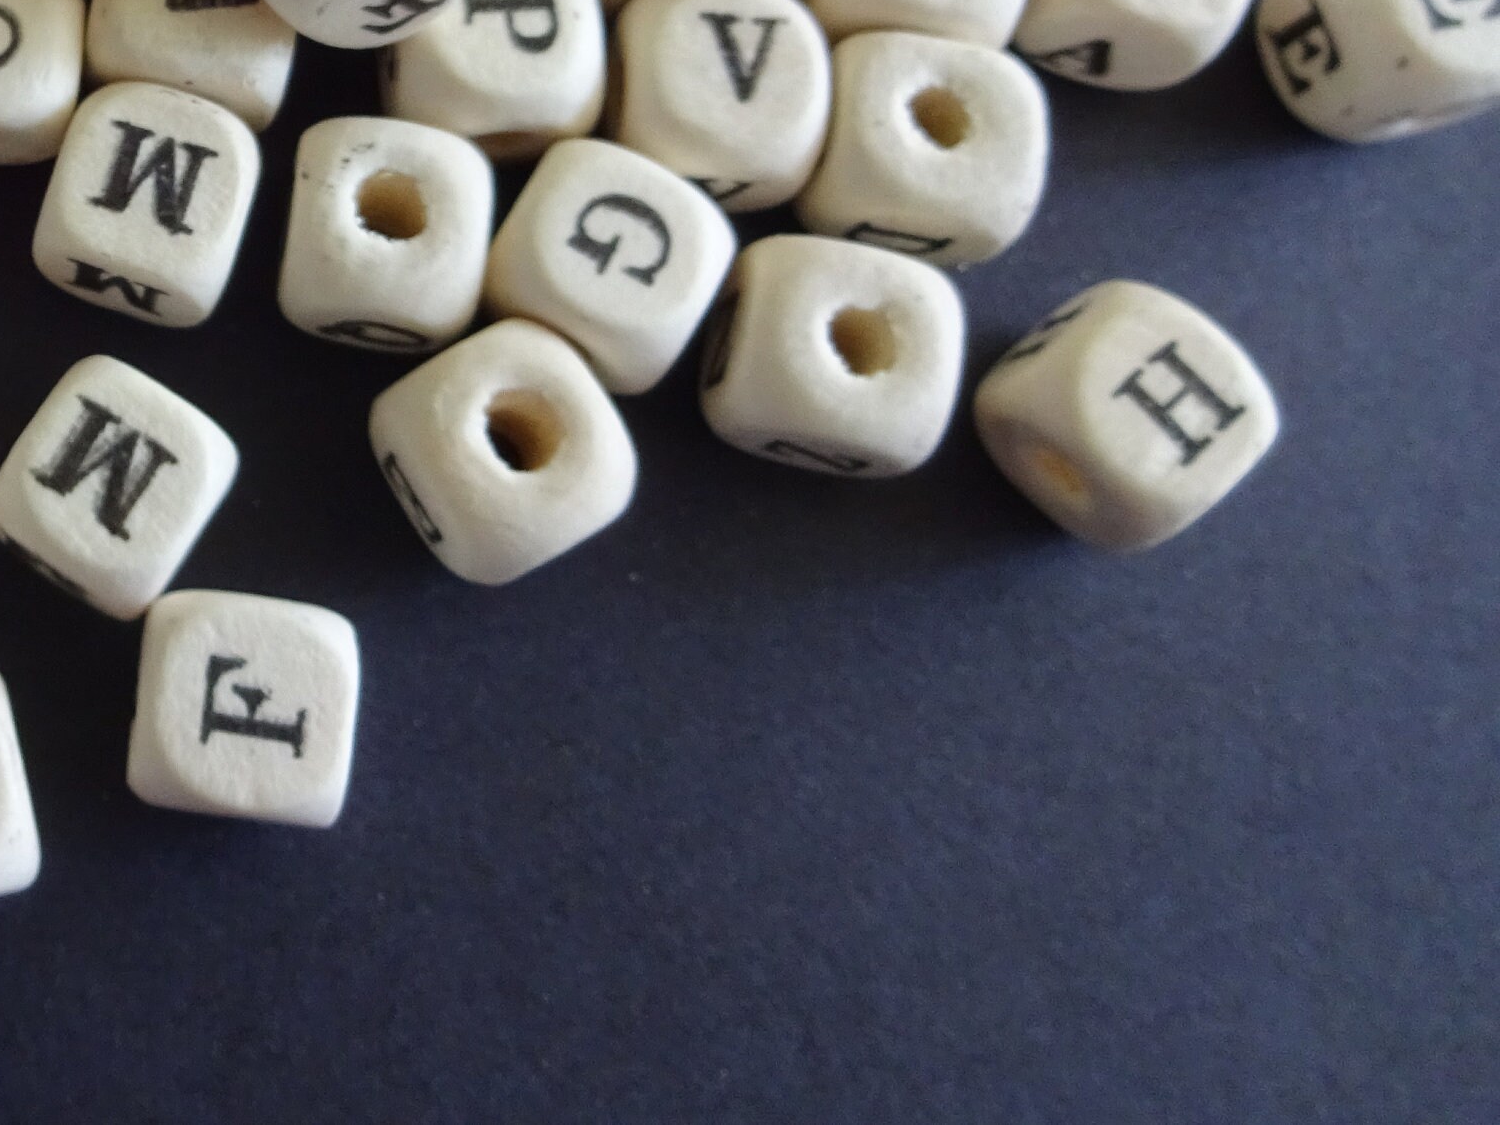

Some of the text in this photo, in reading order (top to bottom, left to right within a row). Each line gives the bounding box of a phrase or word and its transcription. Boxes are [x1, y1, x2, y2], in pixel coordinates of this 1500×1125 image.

[700, 11, 789, 104] V
[88, 118, 219, 237] M
[567, 192, 672, 288] G
[1112, 340, 1246, 467] H
[30, 395, 179, 542] M
[198, 653, 308, 760] F
